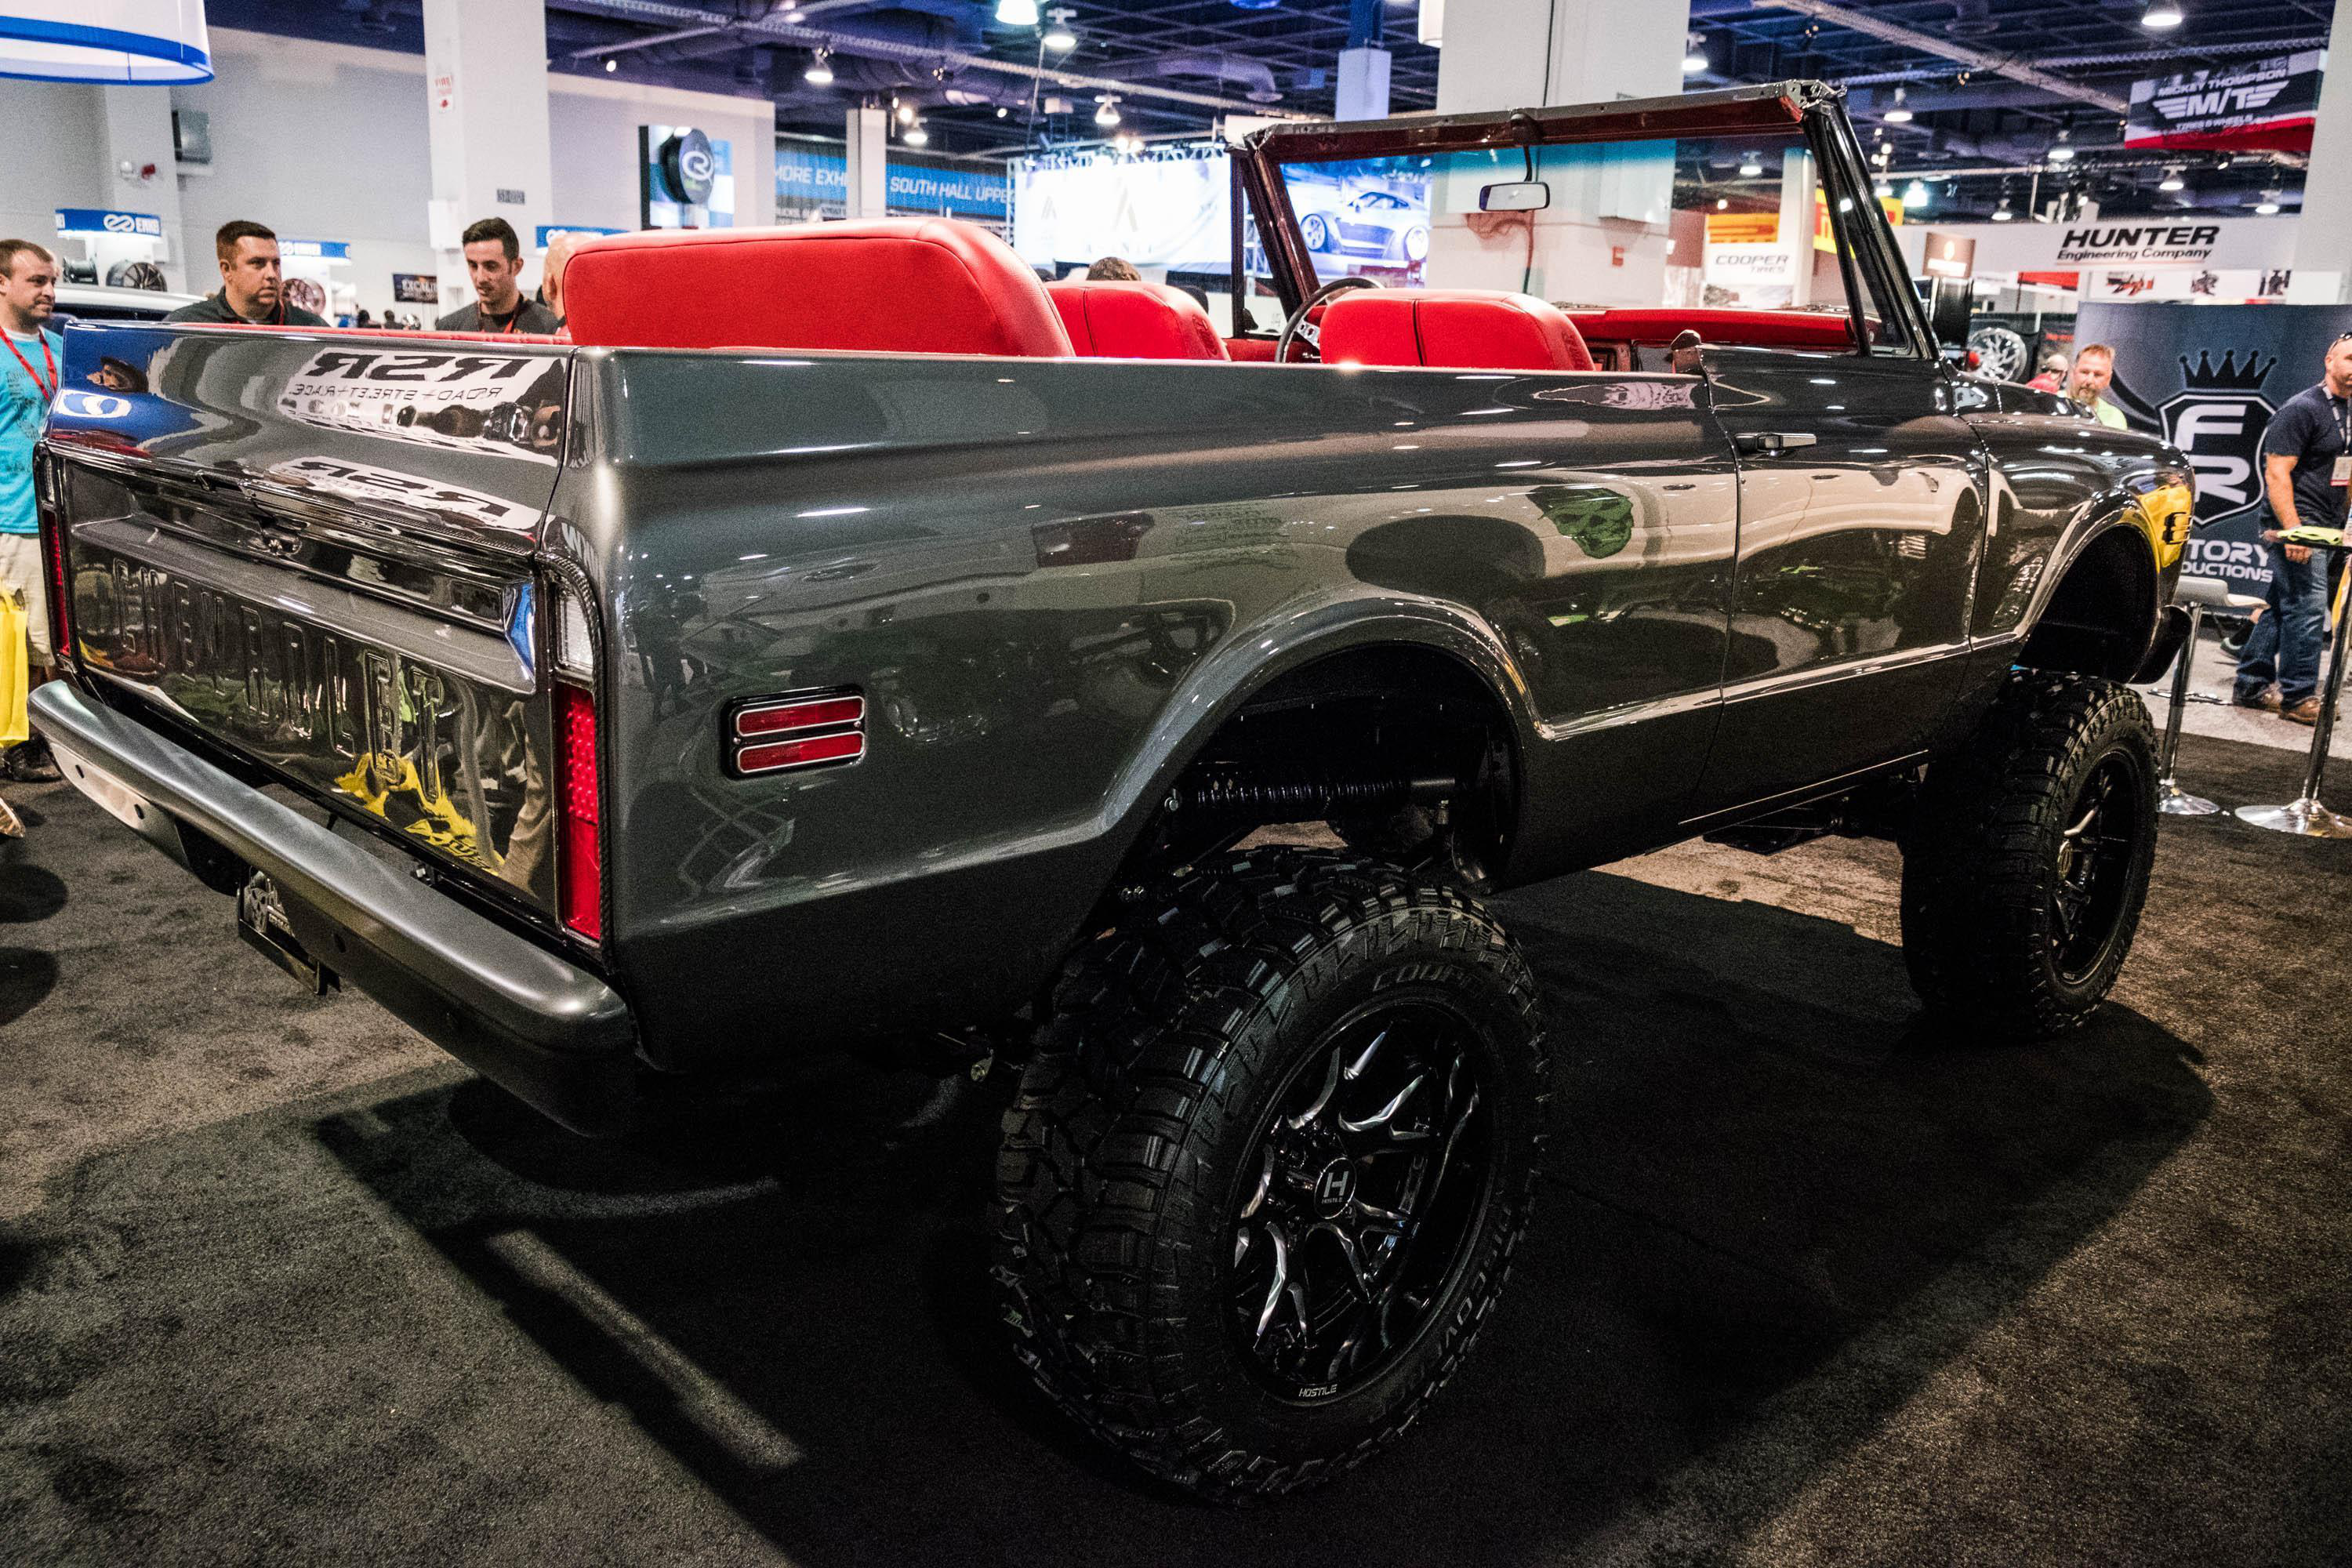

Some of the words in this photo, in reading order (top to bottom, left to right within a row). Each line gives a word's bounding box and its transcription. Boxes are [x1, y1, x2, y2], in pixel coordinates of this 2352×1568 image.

[2158, 79, 2204, 96] MICKEY
[2208, 69, 2287, 90] THOMPSON
[2213, 114, 2253, 128] WHEELS
[890, 176, 937, 196] SOUTH
[939, 181, 971, 201] HALL
[2062, 226, 2220, 249] HUNTER
[1715, 254, 1790, 265] COOPER
[2057, 249, 2139, 262] Engineering
[2141, 248, 2212, 260] Company
[2187, 539, 2269, 567] TORY
[2180, 561, 2274, 583] DUCTIONS
[114, 558, 444, 803] CHEVROLET
[1323, 1171, 1349, 1198] H
[1298, 1383, 1338, 1398] HOSTILE
